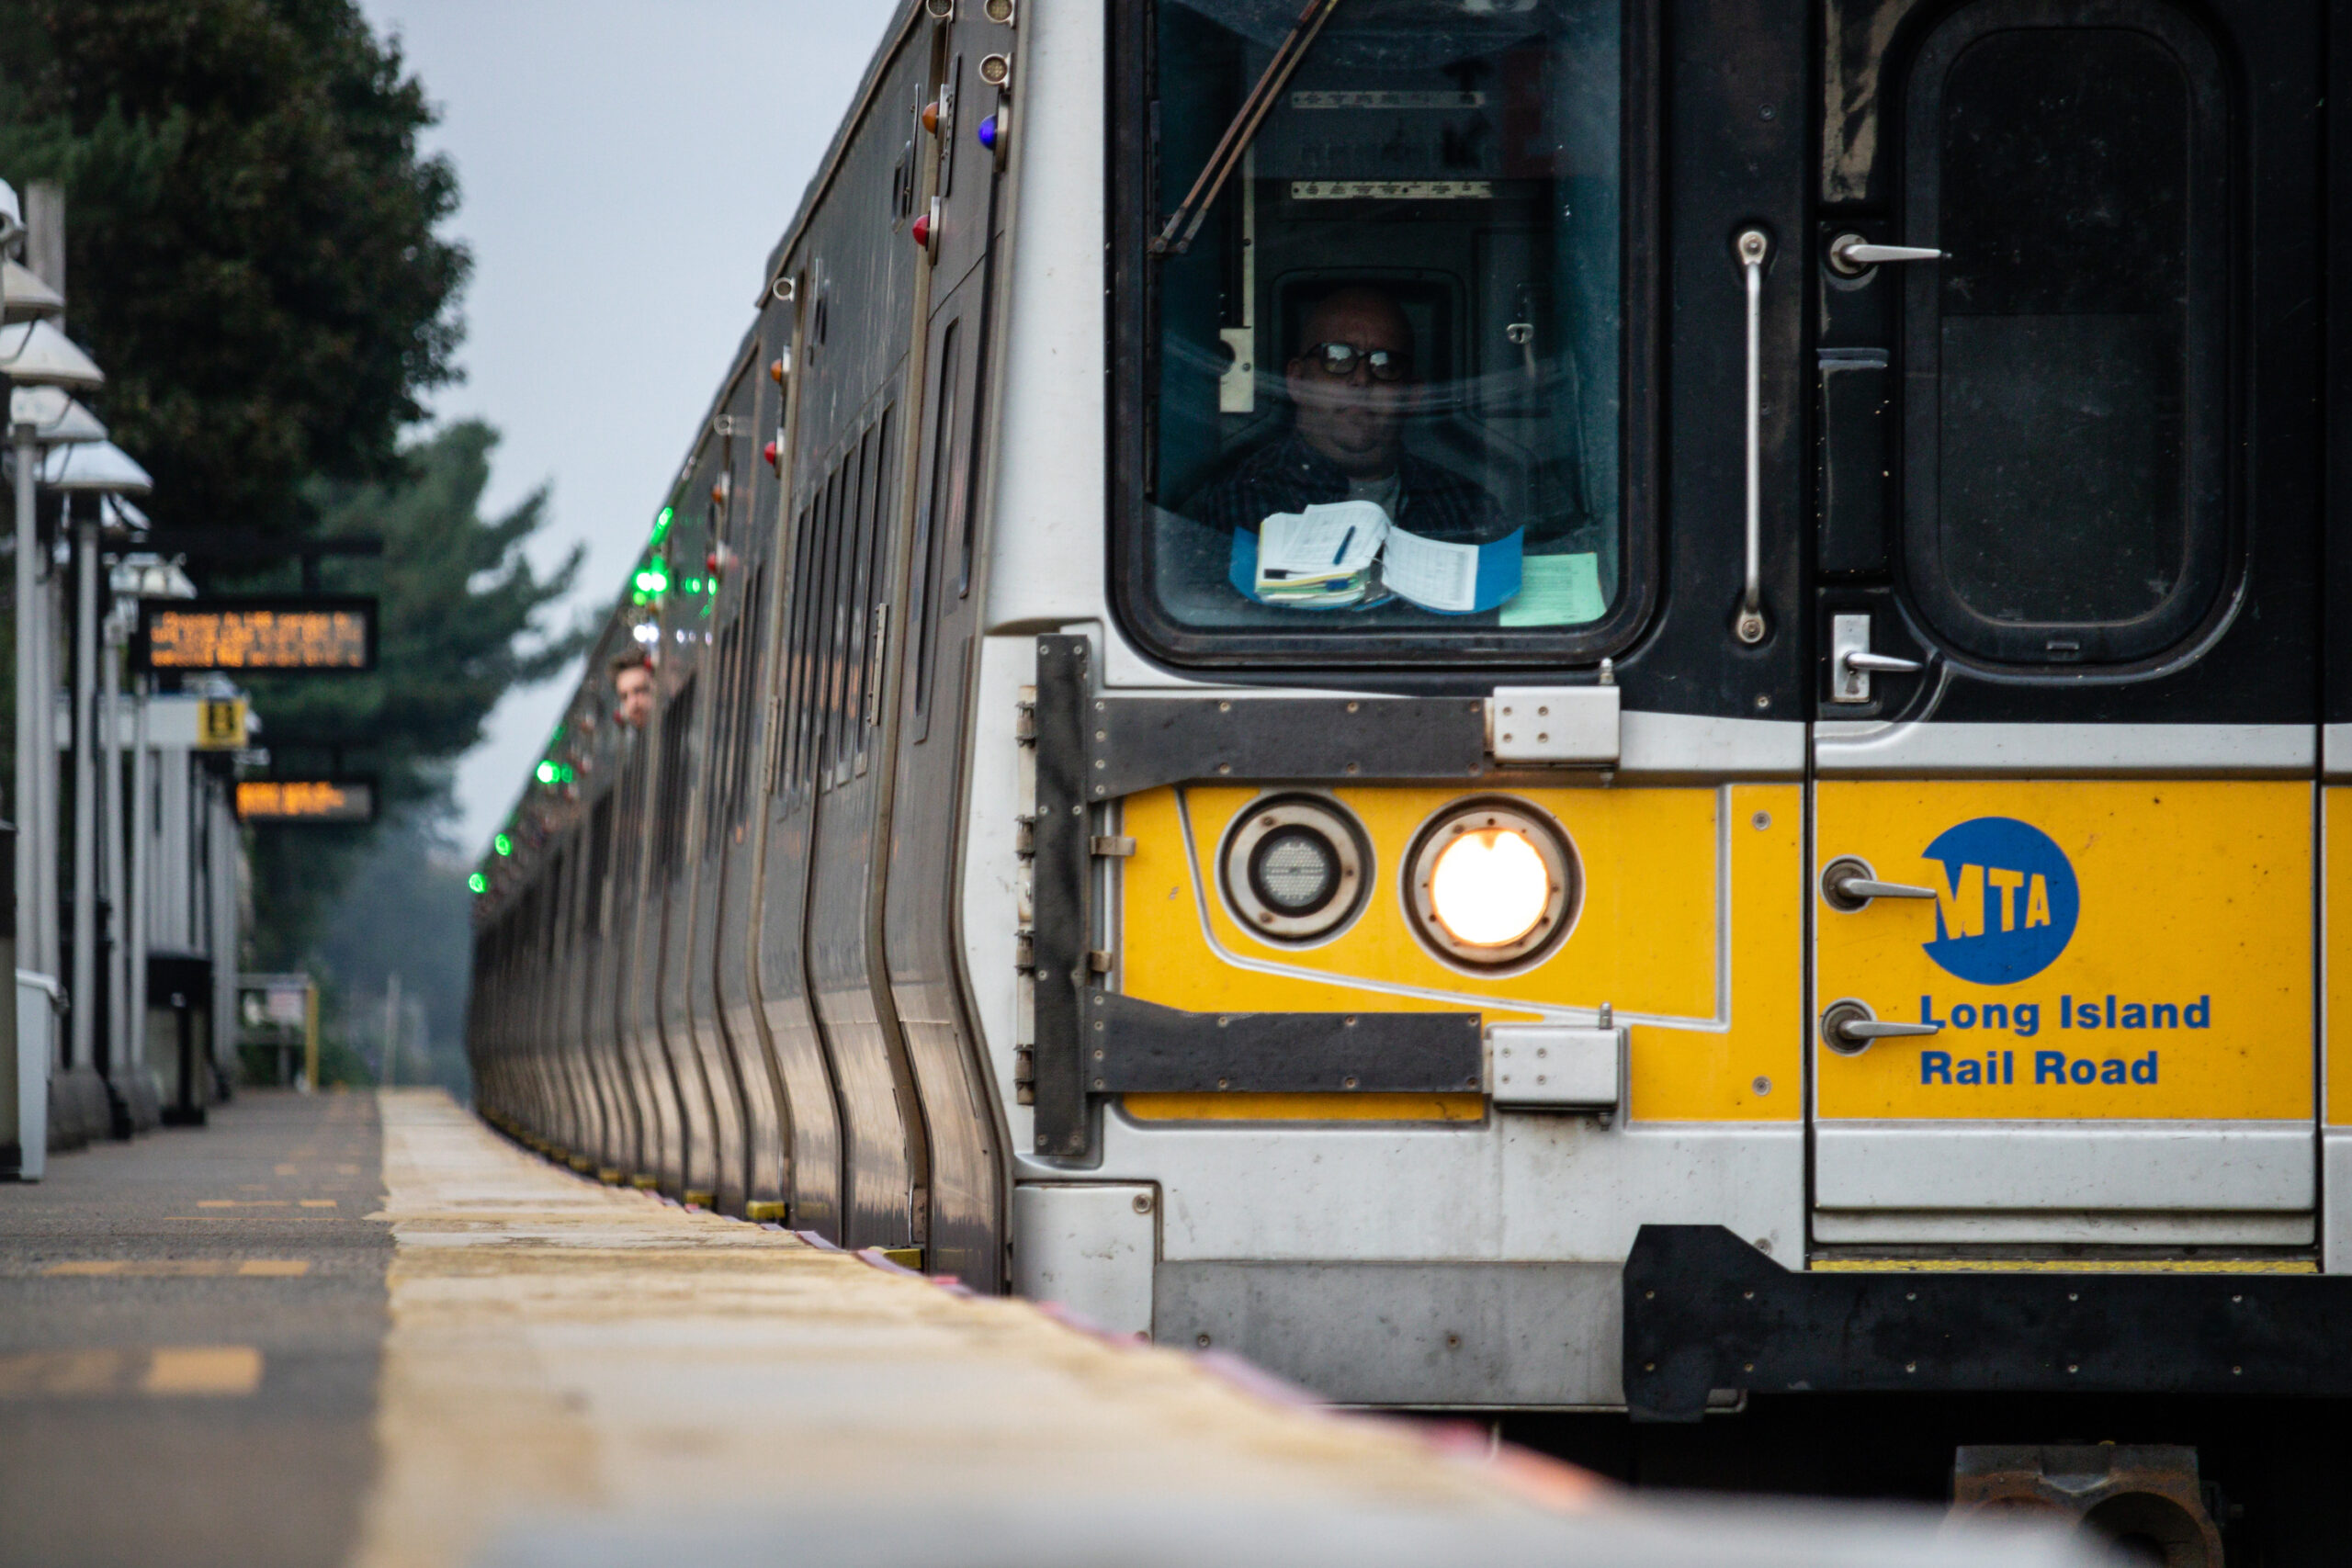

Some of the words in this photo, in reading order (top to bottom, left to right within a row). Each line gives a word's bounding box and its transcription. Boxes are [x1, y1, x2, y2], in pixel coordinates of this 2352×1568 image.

[1922, 857, 2051, 944] MTA
[1920, 995, 2041, 1036] Long
[2061, 995, 2211, 1029] Island
[1920, 1051, 2014, 1085] Rail
[2035, 1051, 2158, 1085] Road
